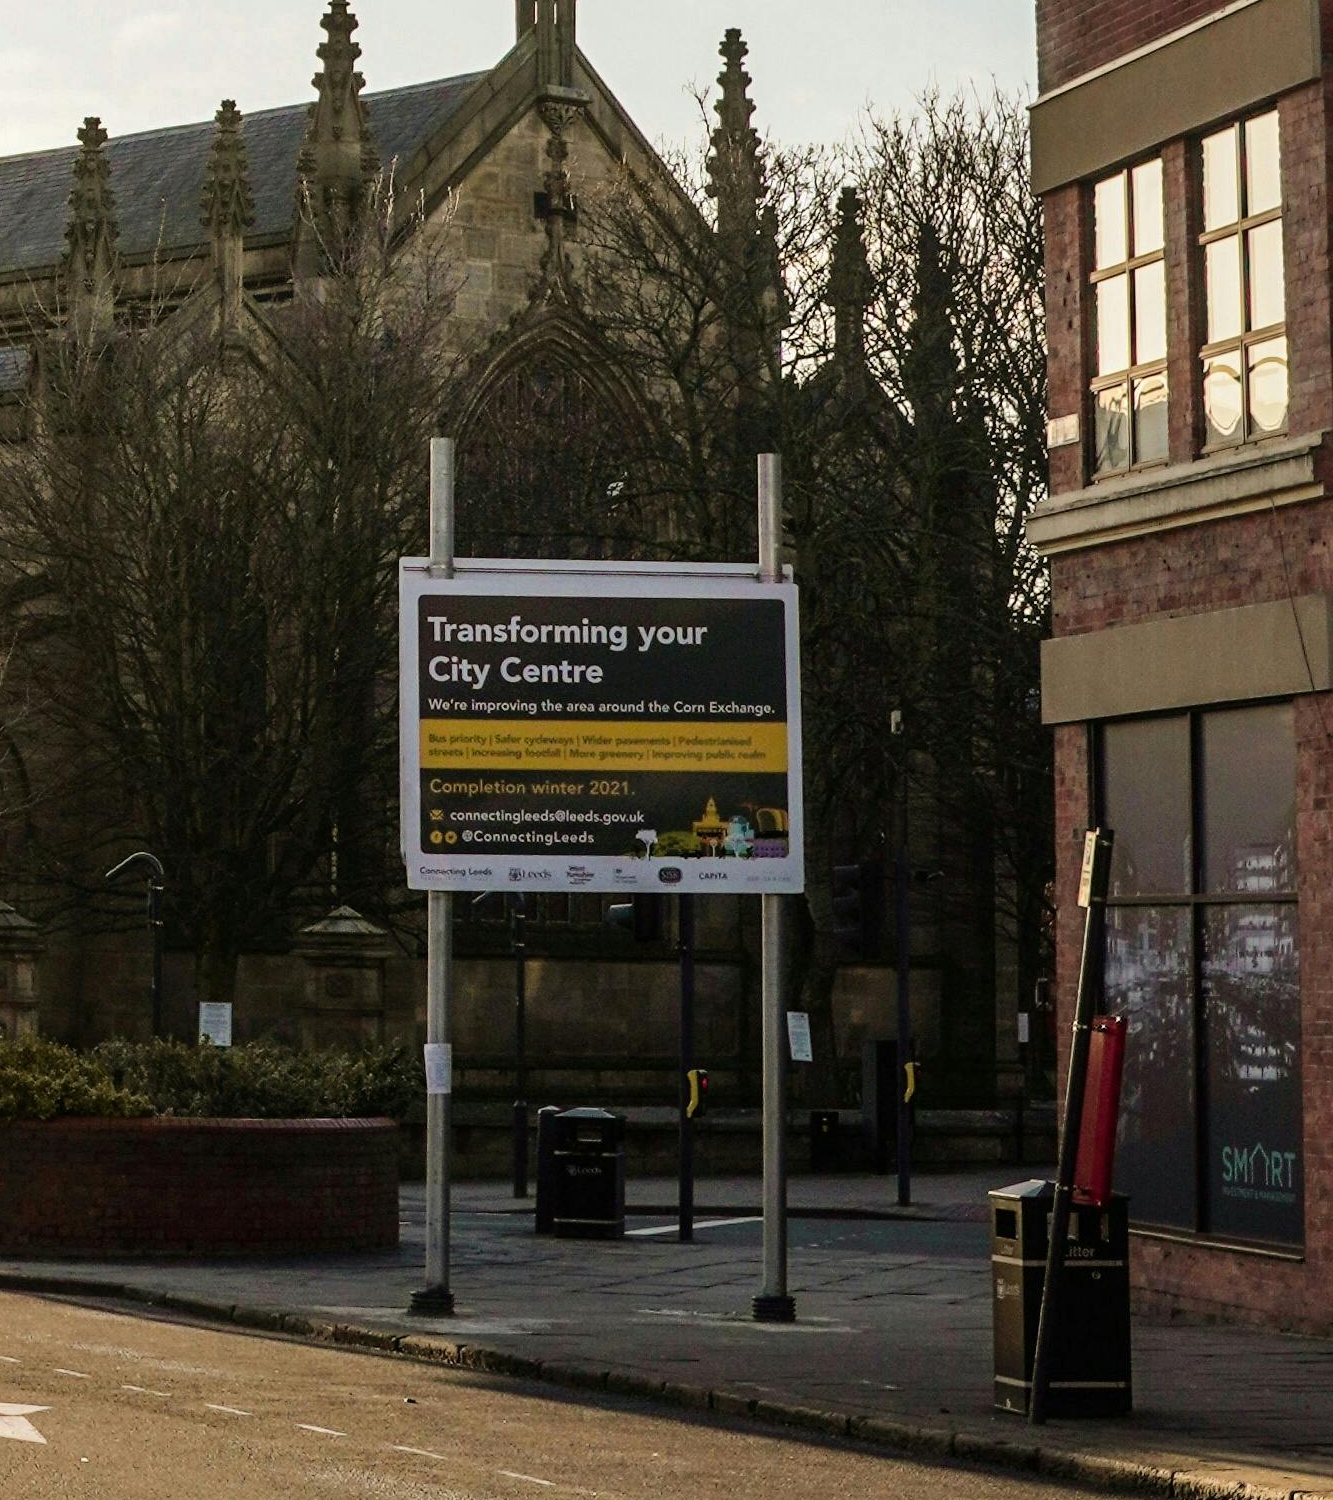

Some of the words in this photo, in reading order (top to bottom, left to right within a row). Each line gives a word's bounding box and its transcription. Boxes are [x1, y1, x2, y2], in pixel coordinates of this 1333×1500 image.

[427, 615, 627, 651] Transforming
[638, 625, 708, 651] your
[428, 656, 490, 690] City
[500, 656, 603, 683] Centre
[428, 698, 468, 711] We're
[471, 699, 538, 714] improving
[541, 700, 563, 712] the
[566, 702, 595, 712] area
[599, 701, 644, 713] around
[648, 701, 670, 713] the
[673, 701, 704, 713] Corn
[709, 701, 775, 717] Exchange.
[428, 734, 447, 743] Bus
[450, 734, 487, 746] priority
[494, 735, 521, 744] Safer
[524, 735, 574, 747] cycleways
[582, 735, 612, 745] Wider
[615, 736, 670, 747] pavements
[569, 749, 596, 758] More
[599, 751, 645, 761] greenery
[652, 750, 703, 761] Improving
[706, 750, 734, 761] public
[738, 750, 766, 760] realm
[430, 778, 525, 797] Completion
[532, 780, 584, 795] winter
[589, 781, 636, 796] 2021.
[450, 809, 645, 825] connectingleeds@leeds.gov.uk
[461, 830, 595, 846] @ConnectingLeeds
